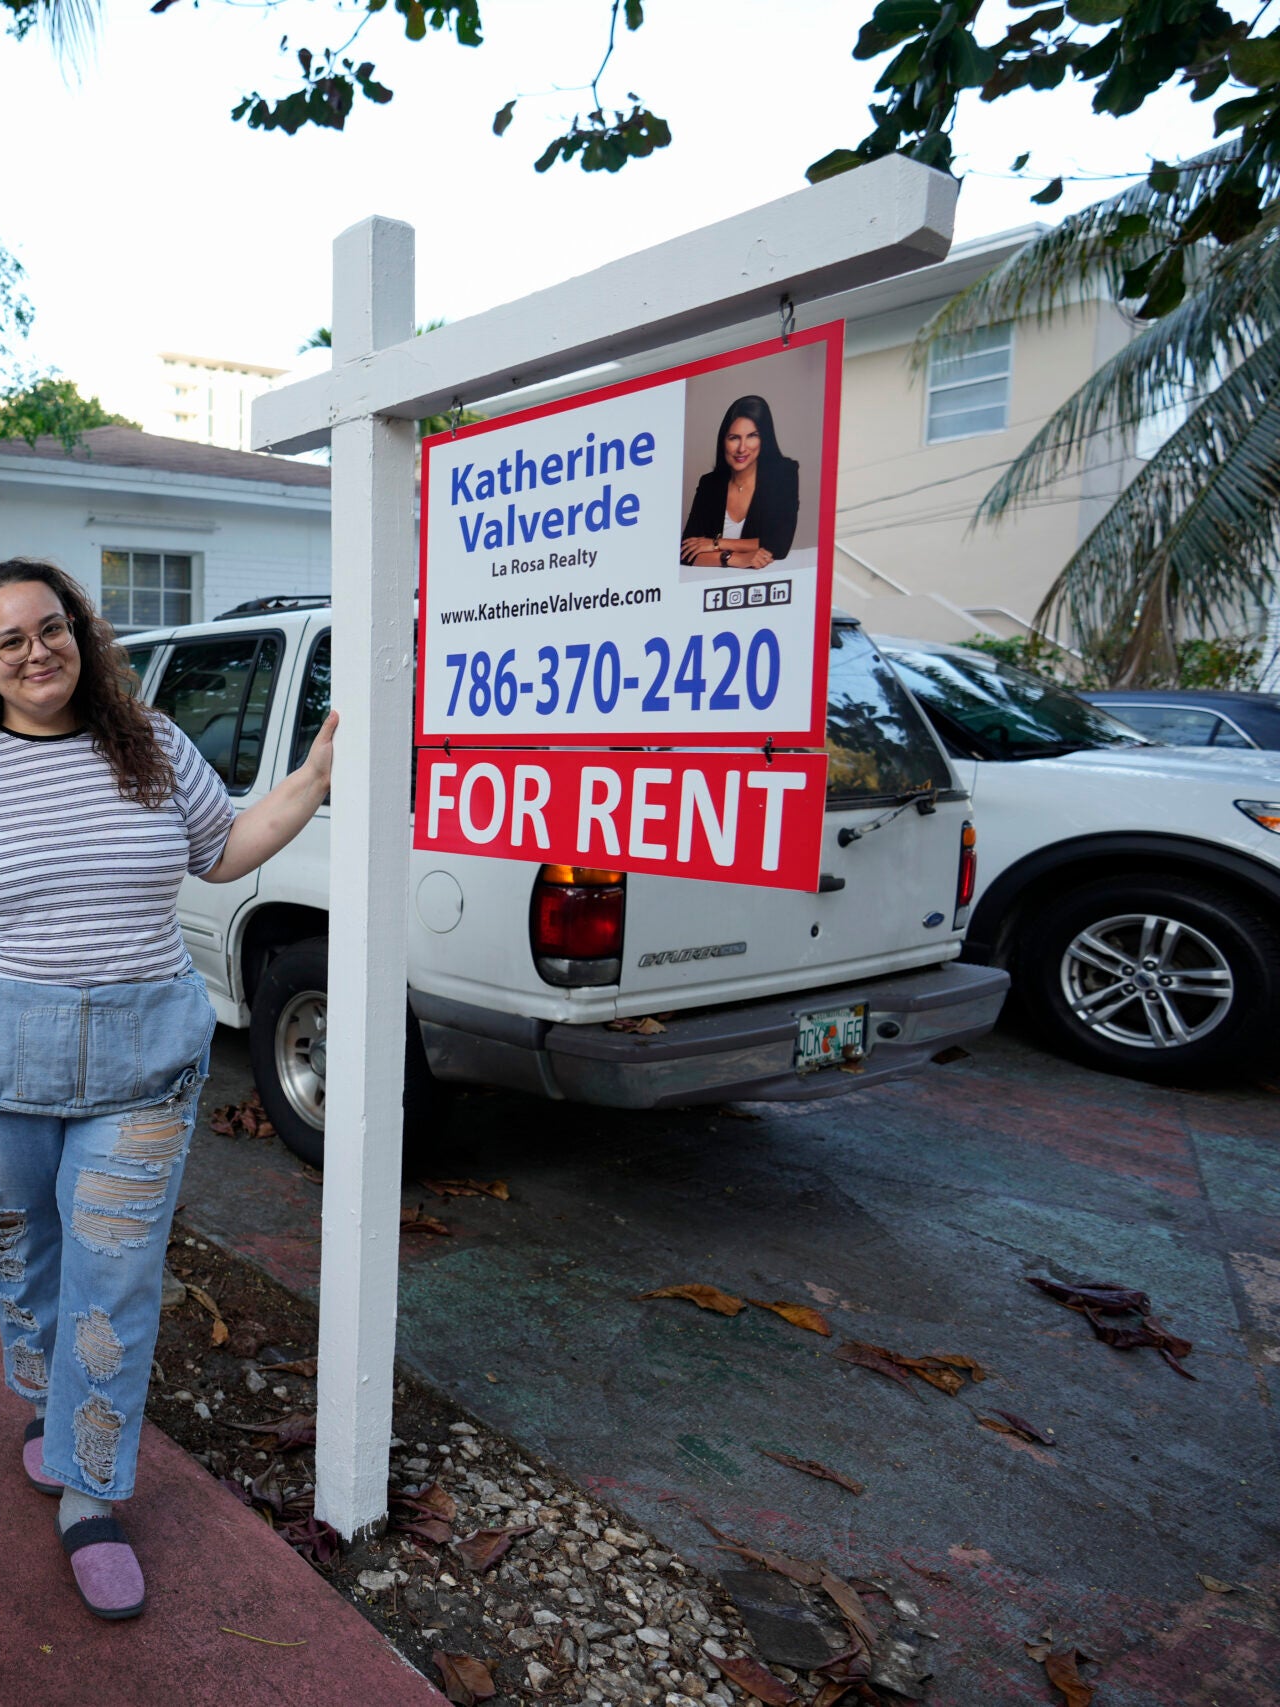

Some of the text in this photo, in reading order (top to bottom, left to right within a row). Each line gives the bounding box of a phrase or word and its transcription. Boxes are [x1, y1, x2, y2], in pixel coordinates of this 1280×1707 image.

[451, 432, 656, 506] Katherine
[459, 485, 640, 553] Valverde
[492, 549, 598, 578] La Rosa Realty
[440, 587, 662, 625] www.KatherineValverde.com
[446, 628, 780, 717] 786-370-2420
[427, 762, 806, 872] FOR RENT
